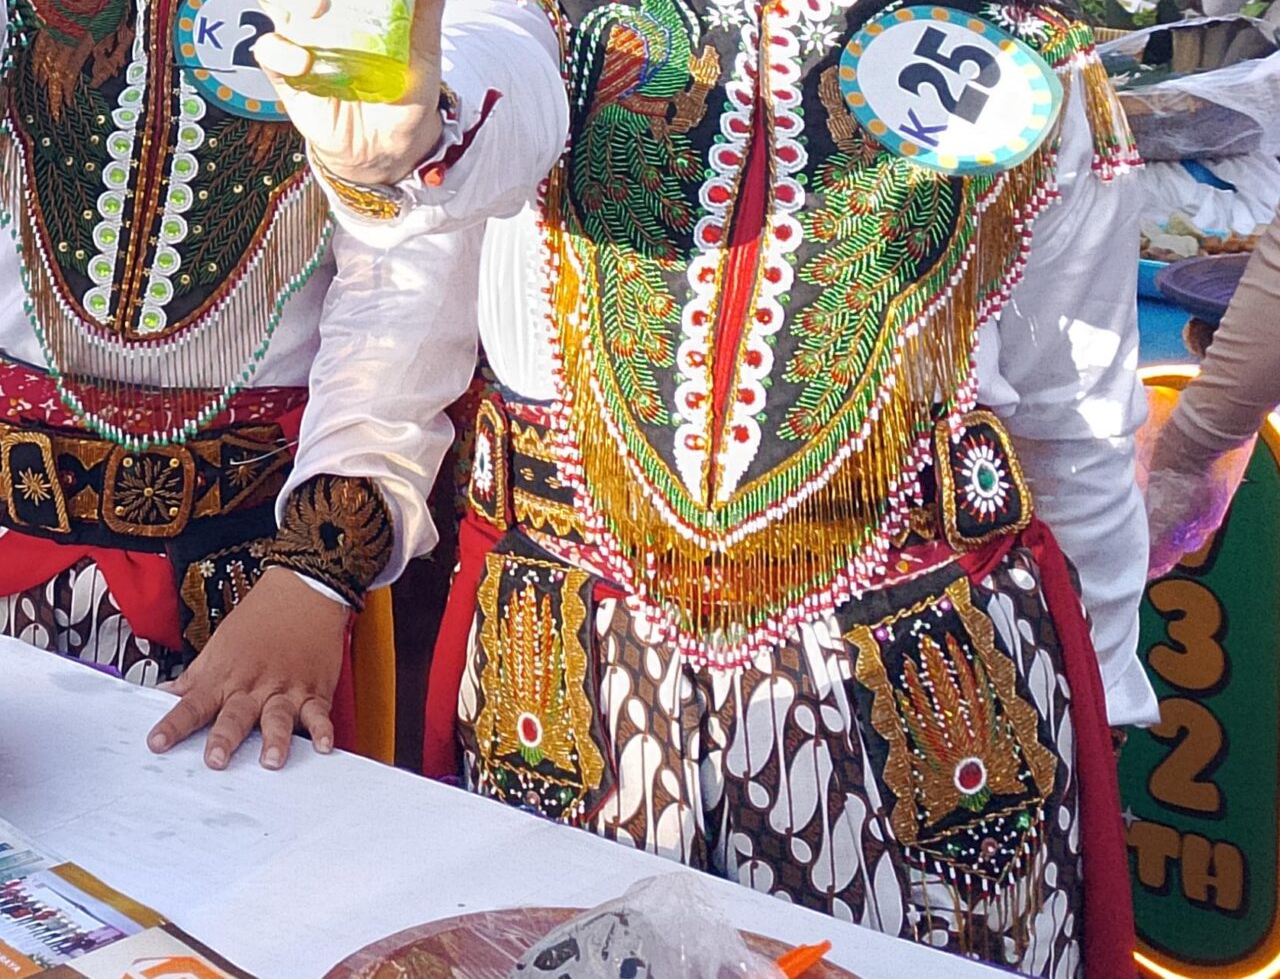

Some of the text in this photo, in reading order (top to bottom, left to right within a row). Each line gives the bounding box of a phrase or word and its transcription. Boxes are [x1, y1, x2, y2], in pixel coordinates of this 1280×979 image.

[197, 16, 225, 50] K
[898, 25, 1002, 148] K 25
[1126, 820, 1245, 912] TH
